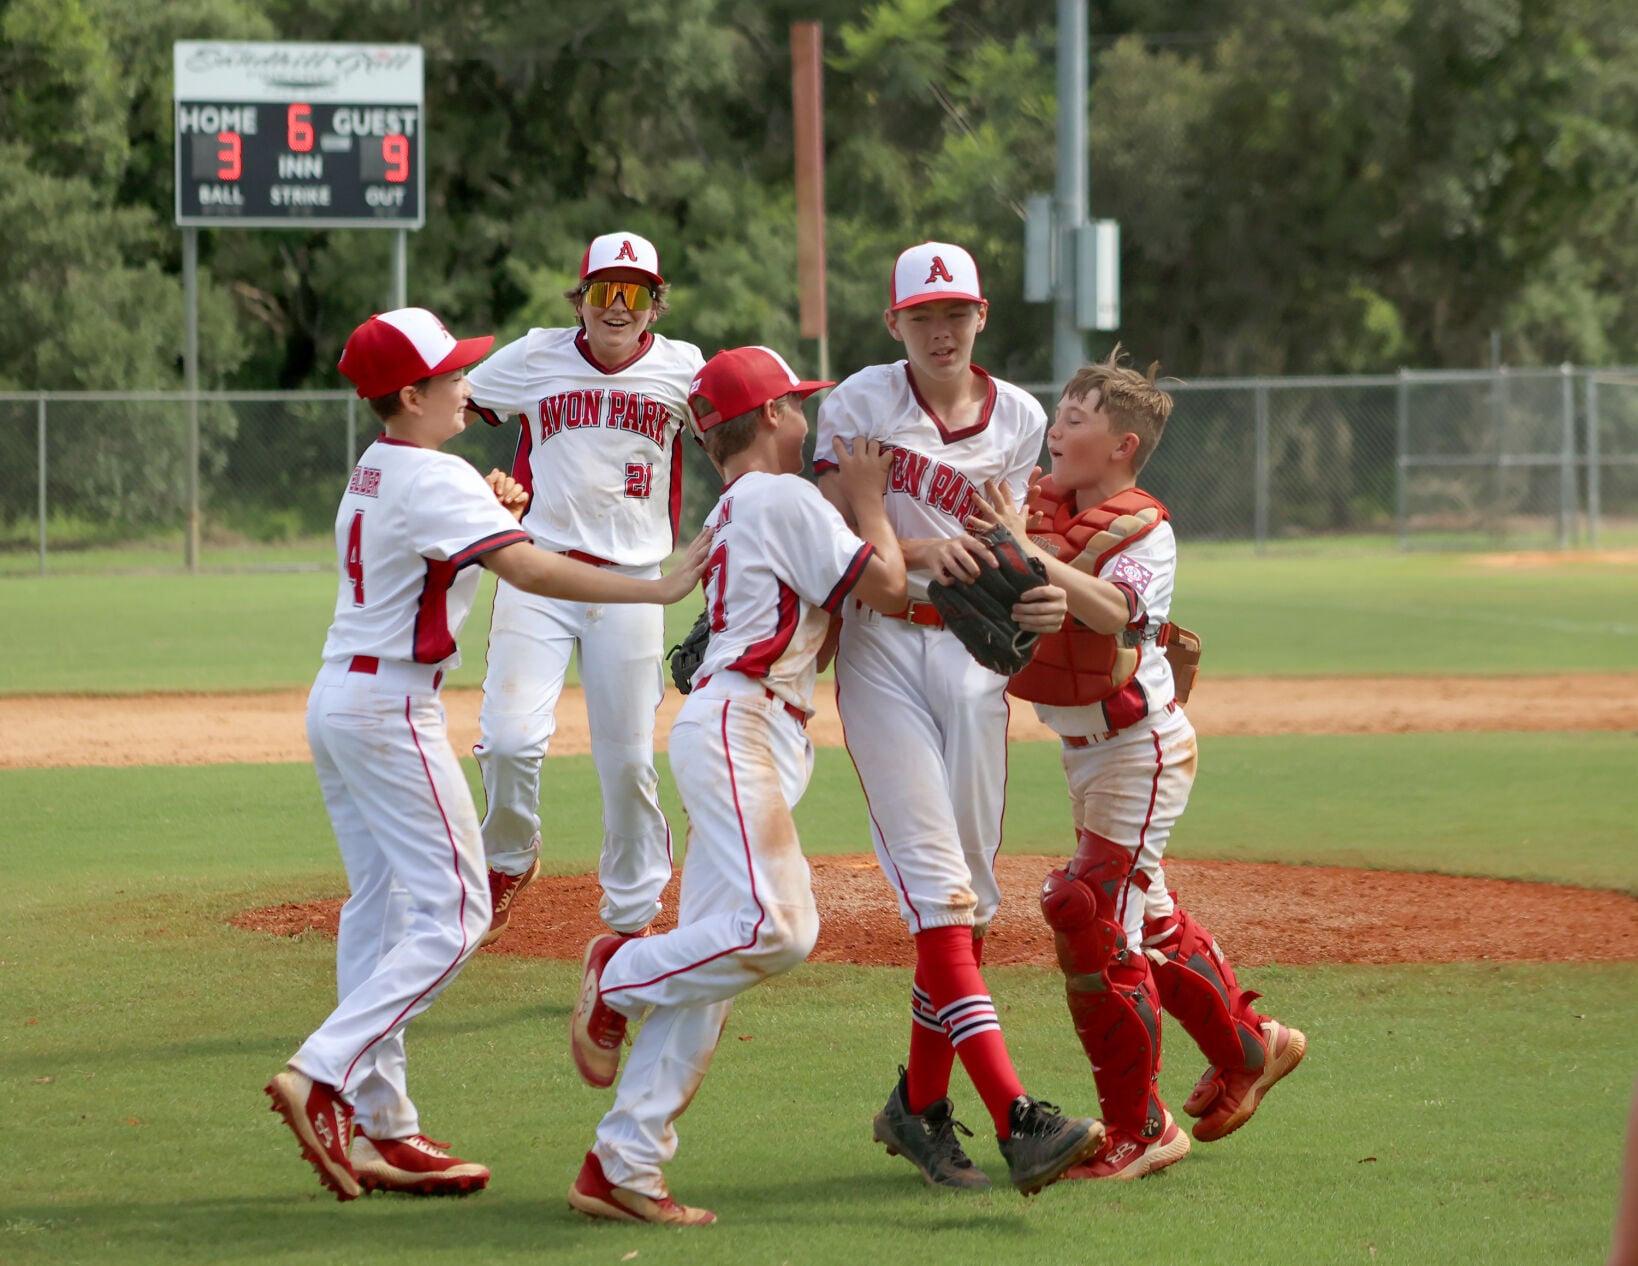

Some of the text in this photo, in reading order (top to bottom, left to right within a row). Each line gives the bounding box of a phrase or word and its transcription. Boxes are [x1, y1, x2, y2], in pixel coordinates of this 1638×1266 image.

[179, 106, 258, 135] HOME
[287, 102, 314, 152] 6
[332, 108, 417, 136] GUEST
[217, 131, 243, 181] 3
[278, 154, 323, 179] INN
[381, 133, 410, 183] 9
[198, 184, 245, 205] BALL
[269, 185, 331, 206] STRIKE
[365, 186, 406, 206] OUT
[614, 240, 638, 262] A
[924, 256, 953, 285] A
[538, 389, 673, 451] AVON PARK
[624, 463, 653, 499] 21
[880, 445, 932, 500] ON
[344, 509, 366, 609] 4
